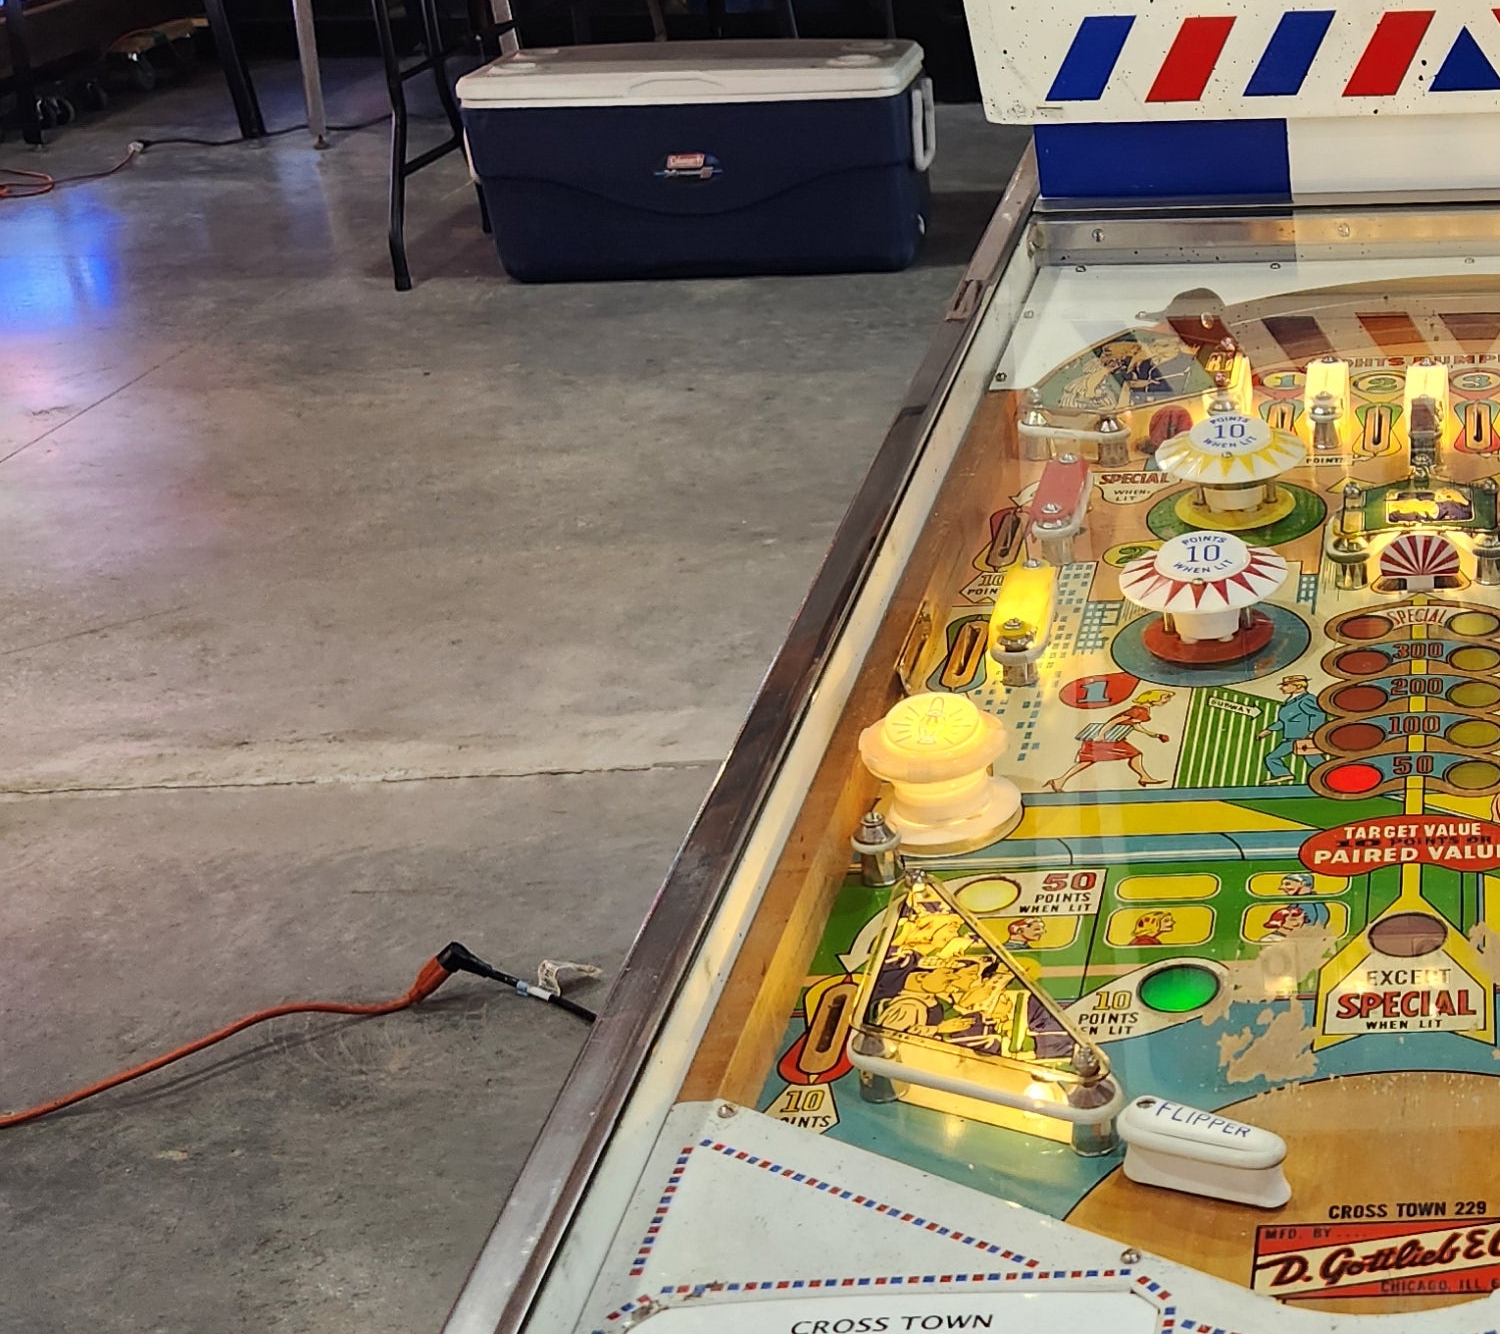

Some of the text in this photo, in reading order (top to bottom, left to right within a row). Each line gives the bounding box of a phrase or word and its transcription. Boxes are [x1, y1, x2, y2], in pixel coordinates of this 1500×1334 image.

[1210, 416, 1250, 425] POINTS
[1215, 423, 1246, 439] 10
[1203, 437, 1238, 448] WHEN
[1099, 472, 1171, 485] SPECIAL
[1181, 535, 1227, 546] POINTS
[1186, 544, 1221, 563] 10
[1171, 563, 1214, 575] WHEN
[1386, 607, 1447, 626] SPECIAL
[1393, 642, 1444, 660] 300
[1078, 680, 1113, 703] 1
[1390, 677, 1444, 696] 200
[1208, 697, 1253, 717] SUBWAY
[1387, 716, 1441, 735] 100
[1392, 756, 1435, 775] 50
[1344, 822, 1482, 840] TARGET VALUE
[1390, 837, 1461, 848] POINTS
[1314, 846, 1419, 865] PAIRED
[1041, 872, 1098, 893] 50
[1034, 891, 1092, 905] POINTS
[1018, 902, 1092, 914] WHEN LIT
[1092, 990, 1132, 1011] 10
[1336, 990, 1477, 1019] SPECIAL
[1077, 1010, 1139, 1026] POINTS
[1365, 1019, 1443, 1030] WHEN LIT
[1108, 1025, 1134, 1035] LIT
[780, 1090, 825, 1113] 10
[1153, 1099, 1253, 1140] FLIPPER
[1329, 1200, 1487, 1219] CROSS TOWN 229
[1313, 1227, 1331, 1239] BY
[1319, 1231, 1463, 1285] Gottlieb
[901, 1313, 995, 1332] TOWN
